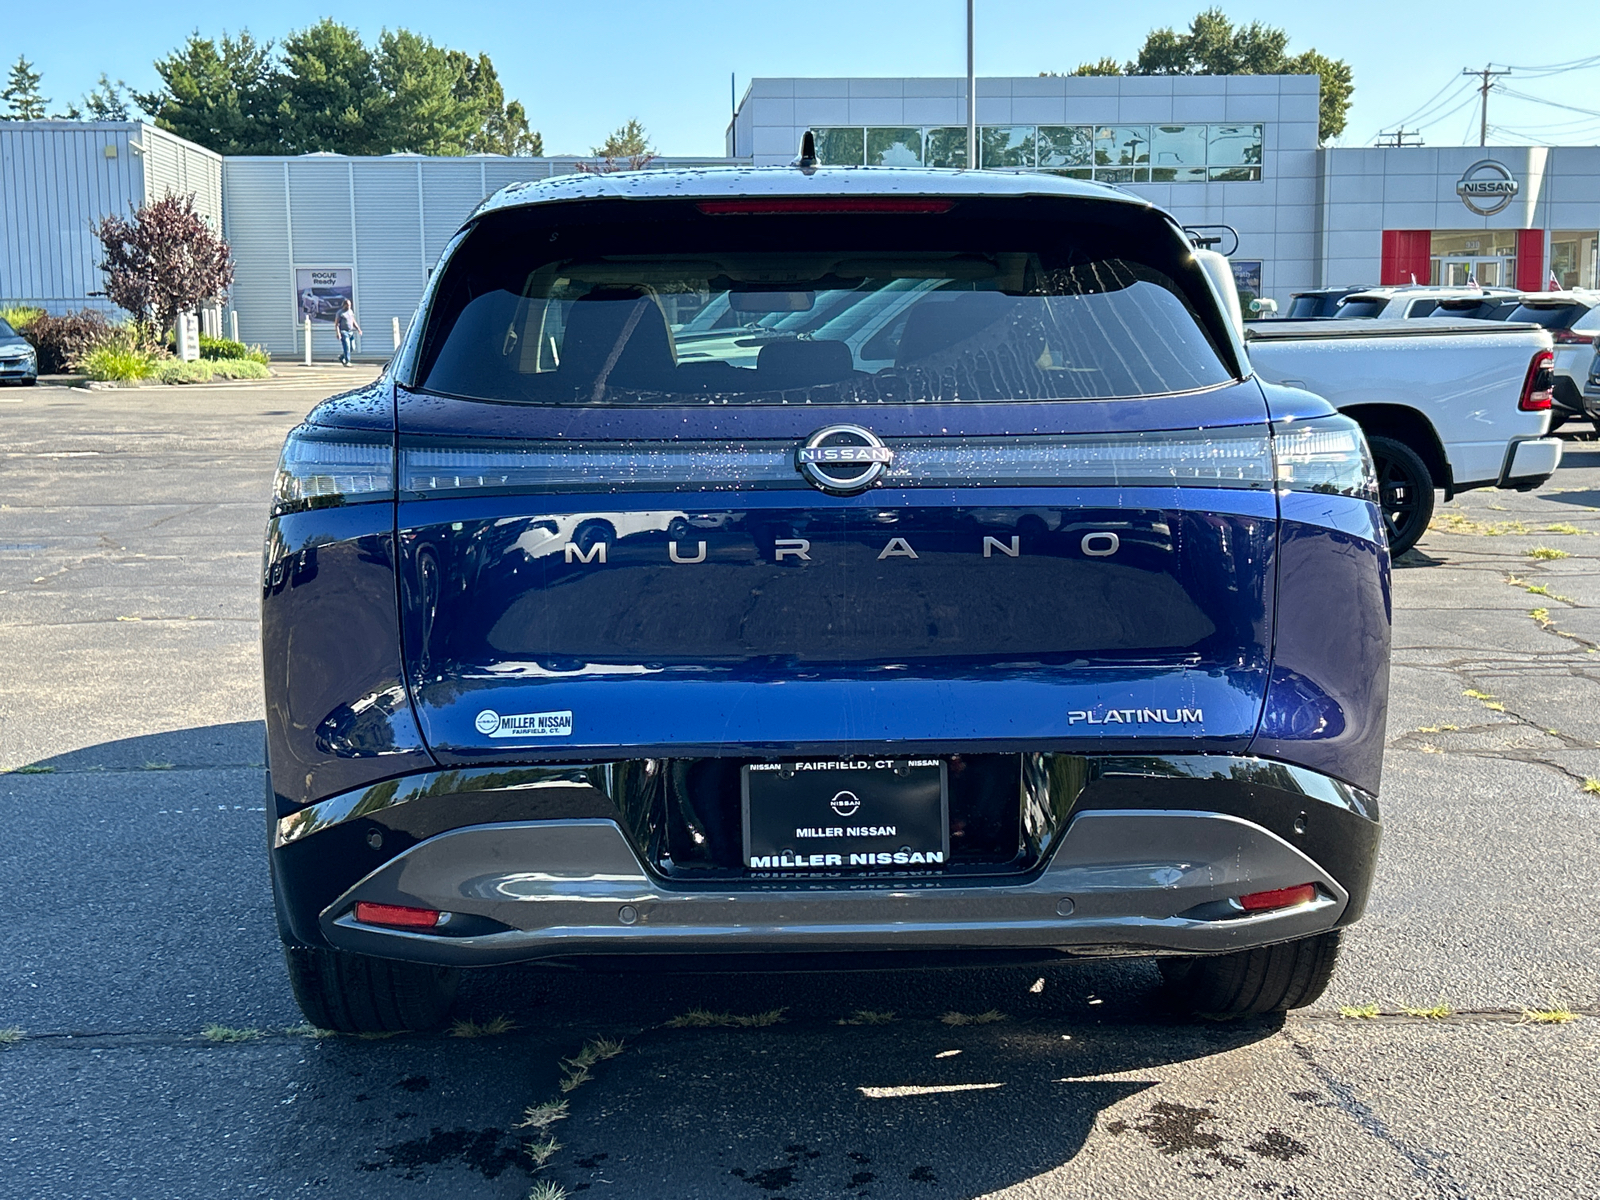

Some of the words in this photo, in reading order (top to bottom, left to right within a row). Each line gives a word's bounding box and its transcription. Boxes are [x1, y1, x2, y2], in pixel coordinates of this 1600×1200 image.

[1464, 183, 1513, 192] NISSAN
[801, 449, 887, 460] NISSAN
[565, 532, 1120, 564] MURANO
[501, 718, 535, 729] MILLER
[538, 716, 571, 727] NISSAN
[1067, 708, 1204, 725] PLATINUM
[795, 761, 871, 771] FAIRFIELD,
[875, 760, 894, 769] CT
[908, 759, 939, 767] NISSAN
[796, 828, 843, 838] MILLER
[847, 826, 896, 836] NISSAN
[751, 854, 842, 868] MILLER
[850, 851, 944, 865] NISSAN
